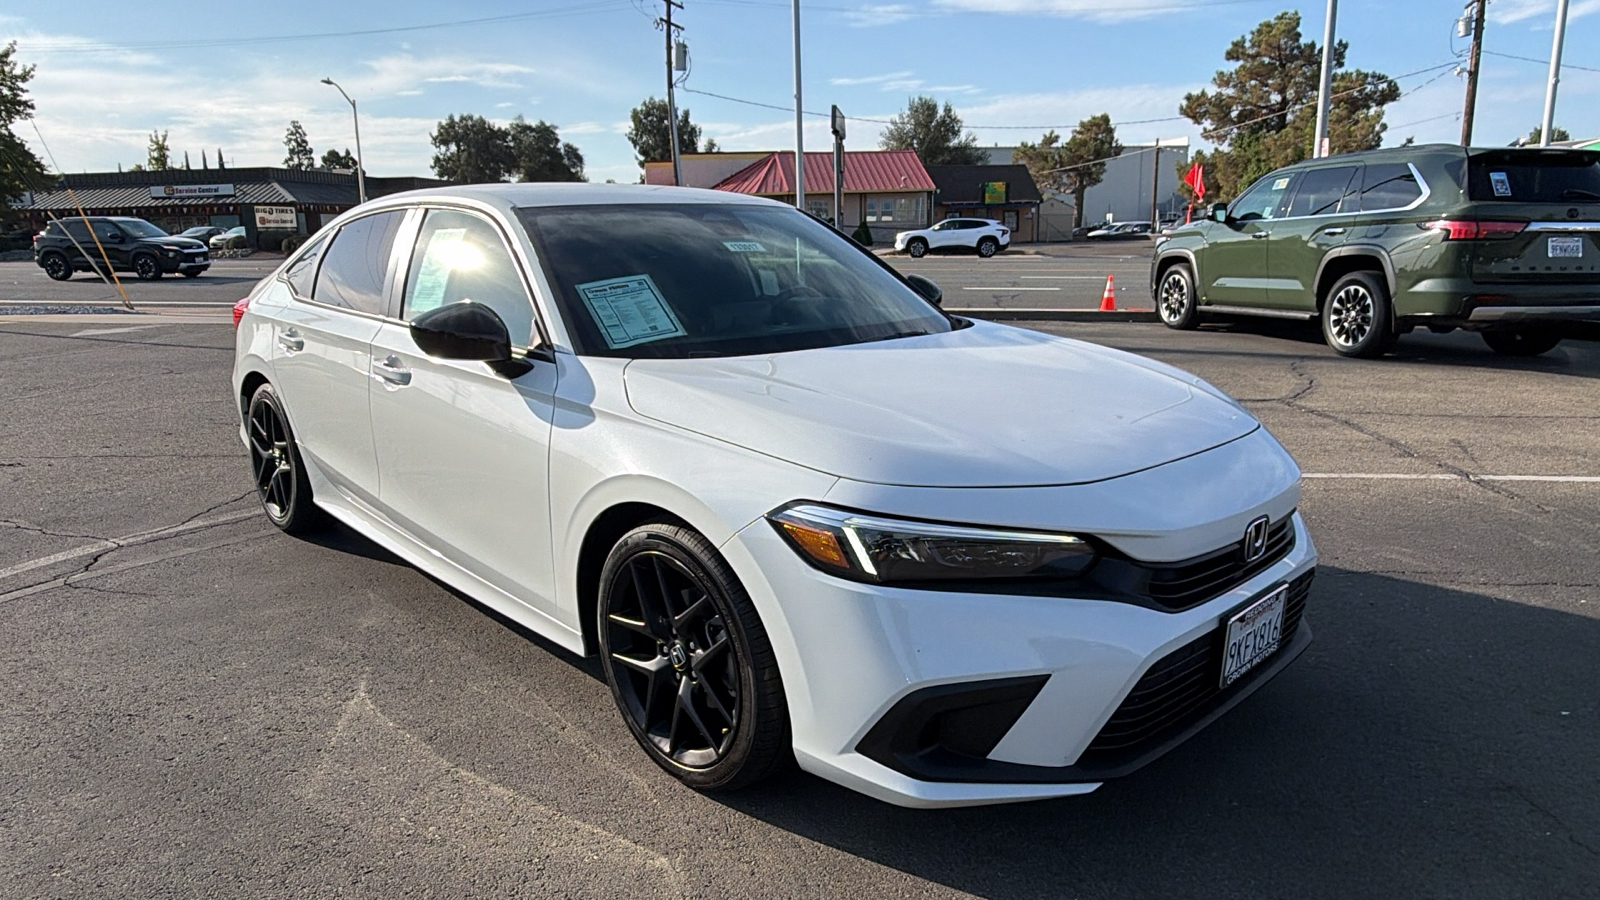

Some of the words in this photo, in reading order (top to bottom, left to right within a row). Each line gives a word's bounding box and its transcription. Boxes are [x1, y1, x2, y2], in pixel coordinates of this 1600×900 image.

[198, 186, 219, 194] Central
[1245, 595, 1277, 619] REDDING
[1227, 611, 1280, 674] 9KFX816
[1226, 660, 1252, 685] CROWN
[1252, 644, 1278, 666] MOTORS
